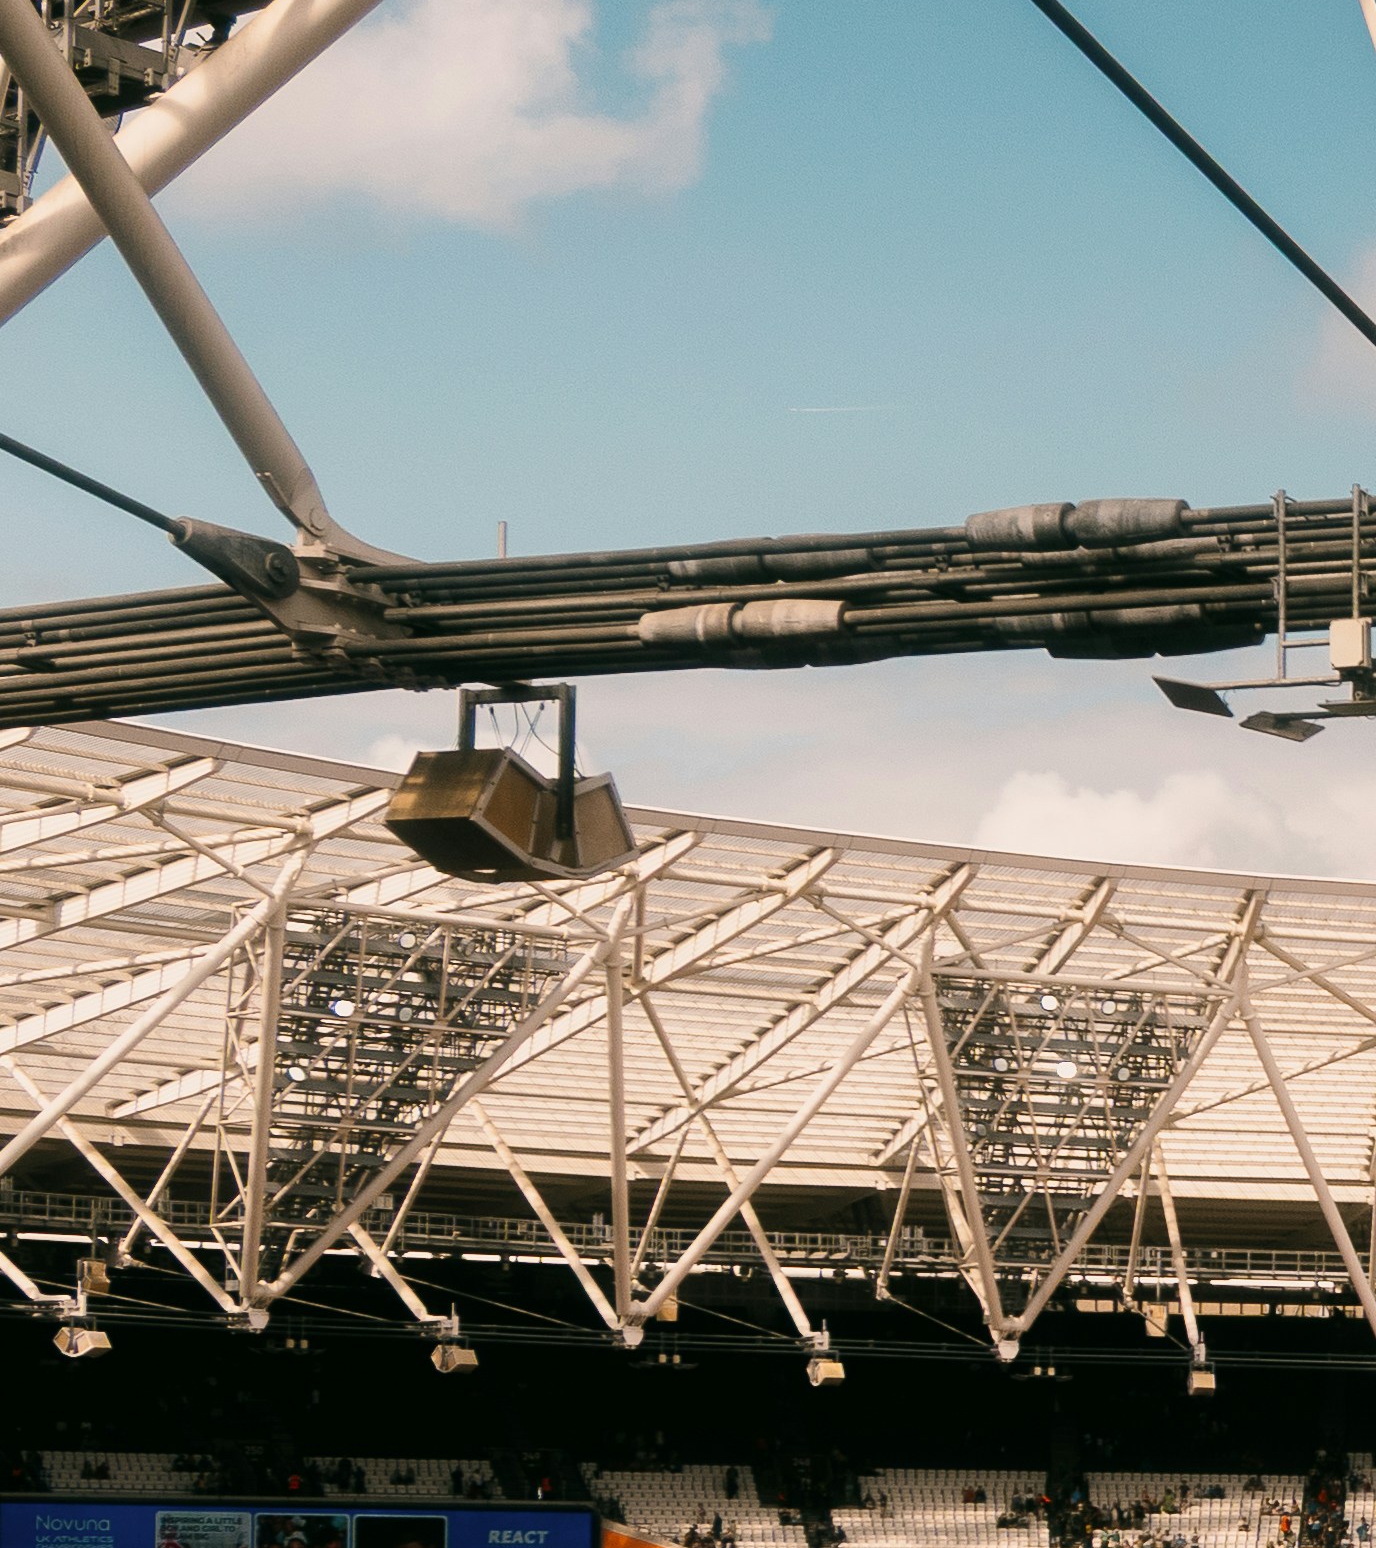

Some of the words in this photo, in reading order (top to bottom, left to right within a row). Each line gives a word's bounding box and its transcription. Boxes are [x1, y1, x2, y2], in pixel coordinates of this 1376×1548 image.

[36, 1516, 110, 1531] Novuna
[53, 1536, 113, 1544] ATHLETICS
[488, 1530, 548, 1544] REACT
